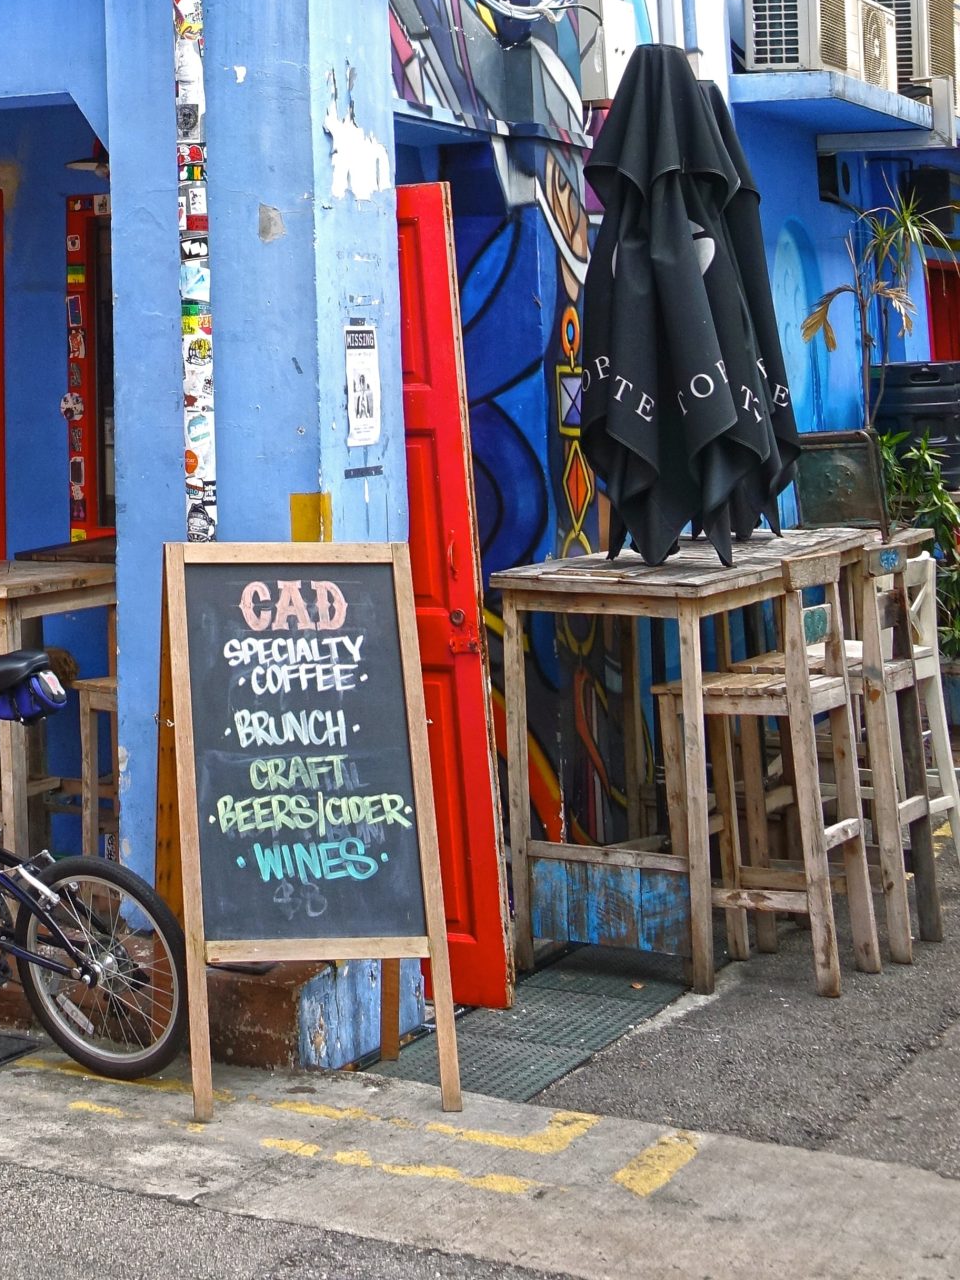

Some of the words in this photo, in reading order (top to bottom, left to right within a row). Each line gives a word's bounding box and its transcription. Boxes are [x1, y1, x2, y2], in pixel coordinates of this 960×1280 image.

[346, 332, 375, 347] MISSING
[239, 580, 349, 632] CAD
[223, 635, 364, 667] SPECIALTY
[250, 663, 359, 695] COFFEE
[234, 709, 349, 749] BRUNCH
[249, 754, 349, 791] CRAFT
[253, 837, 379, 884] WINES
